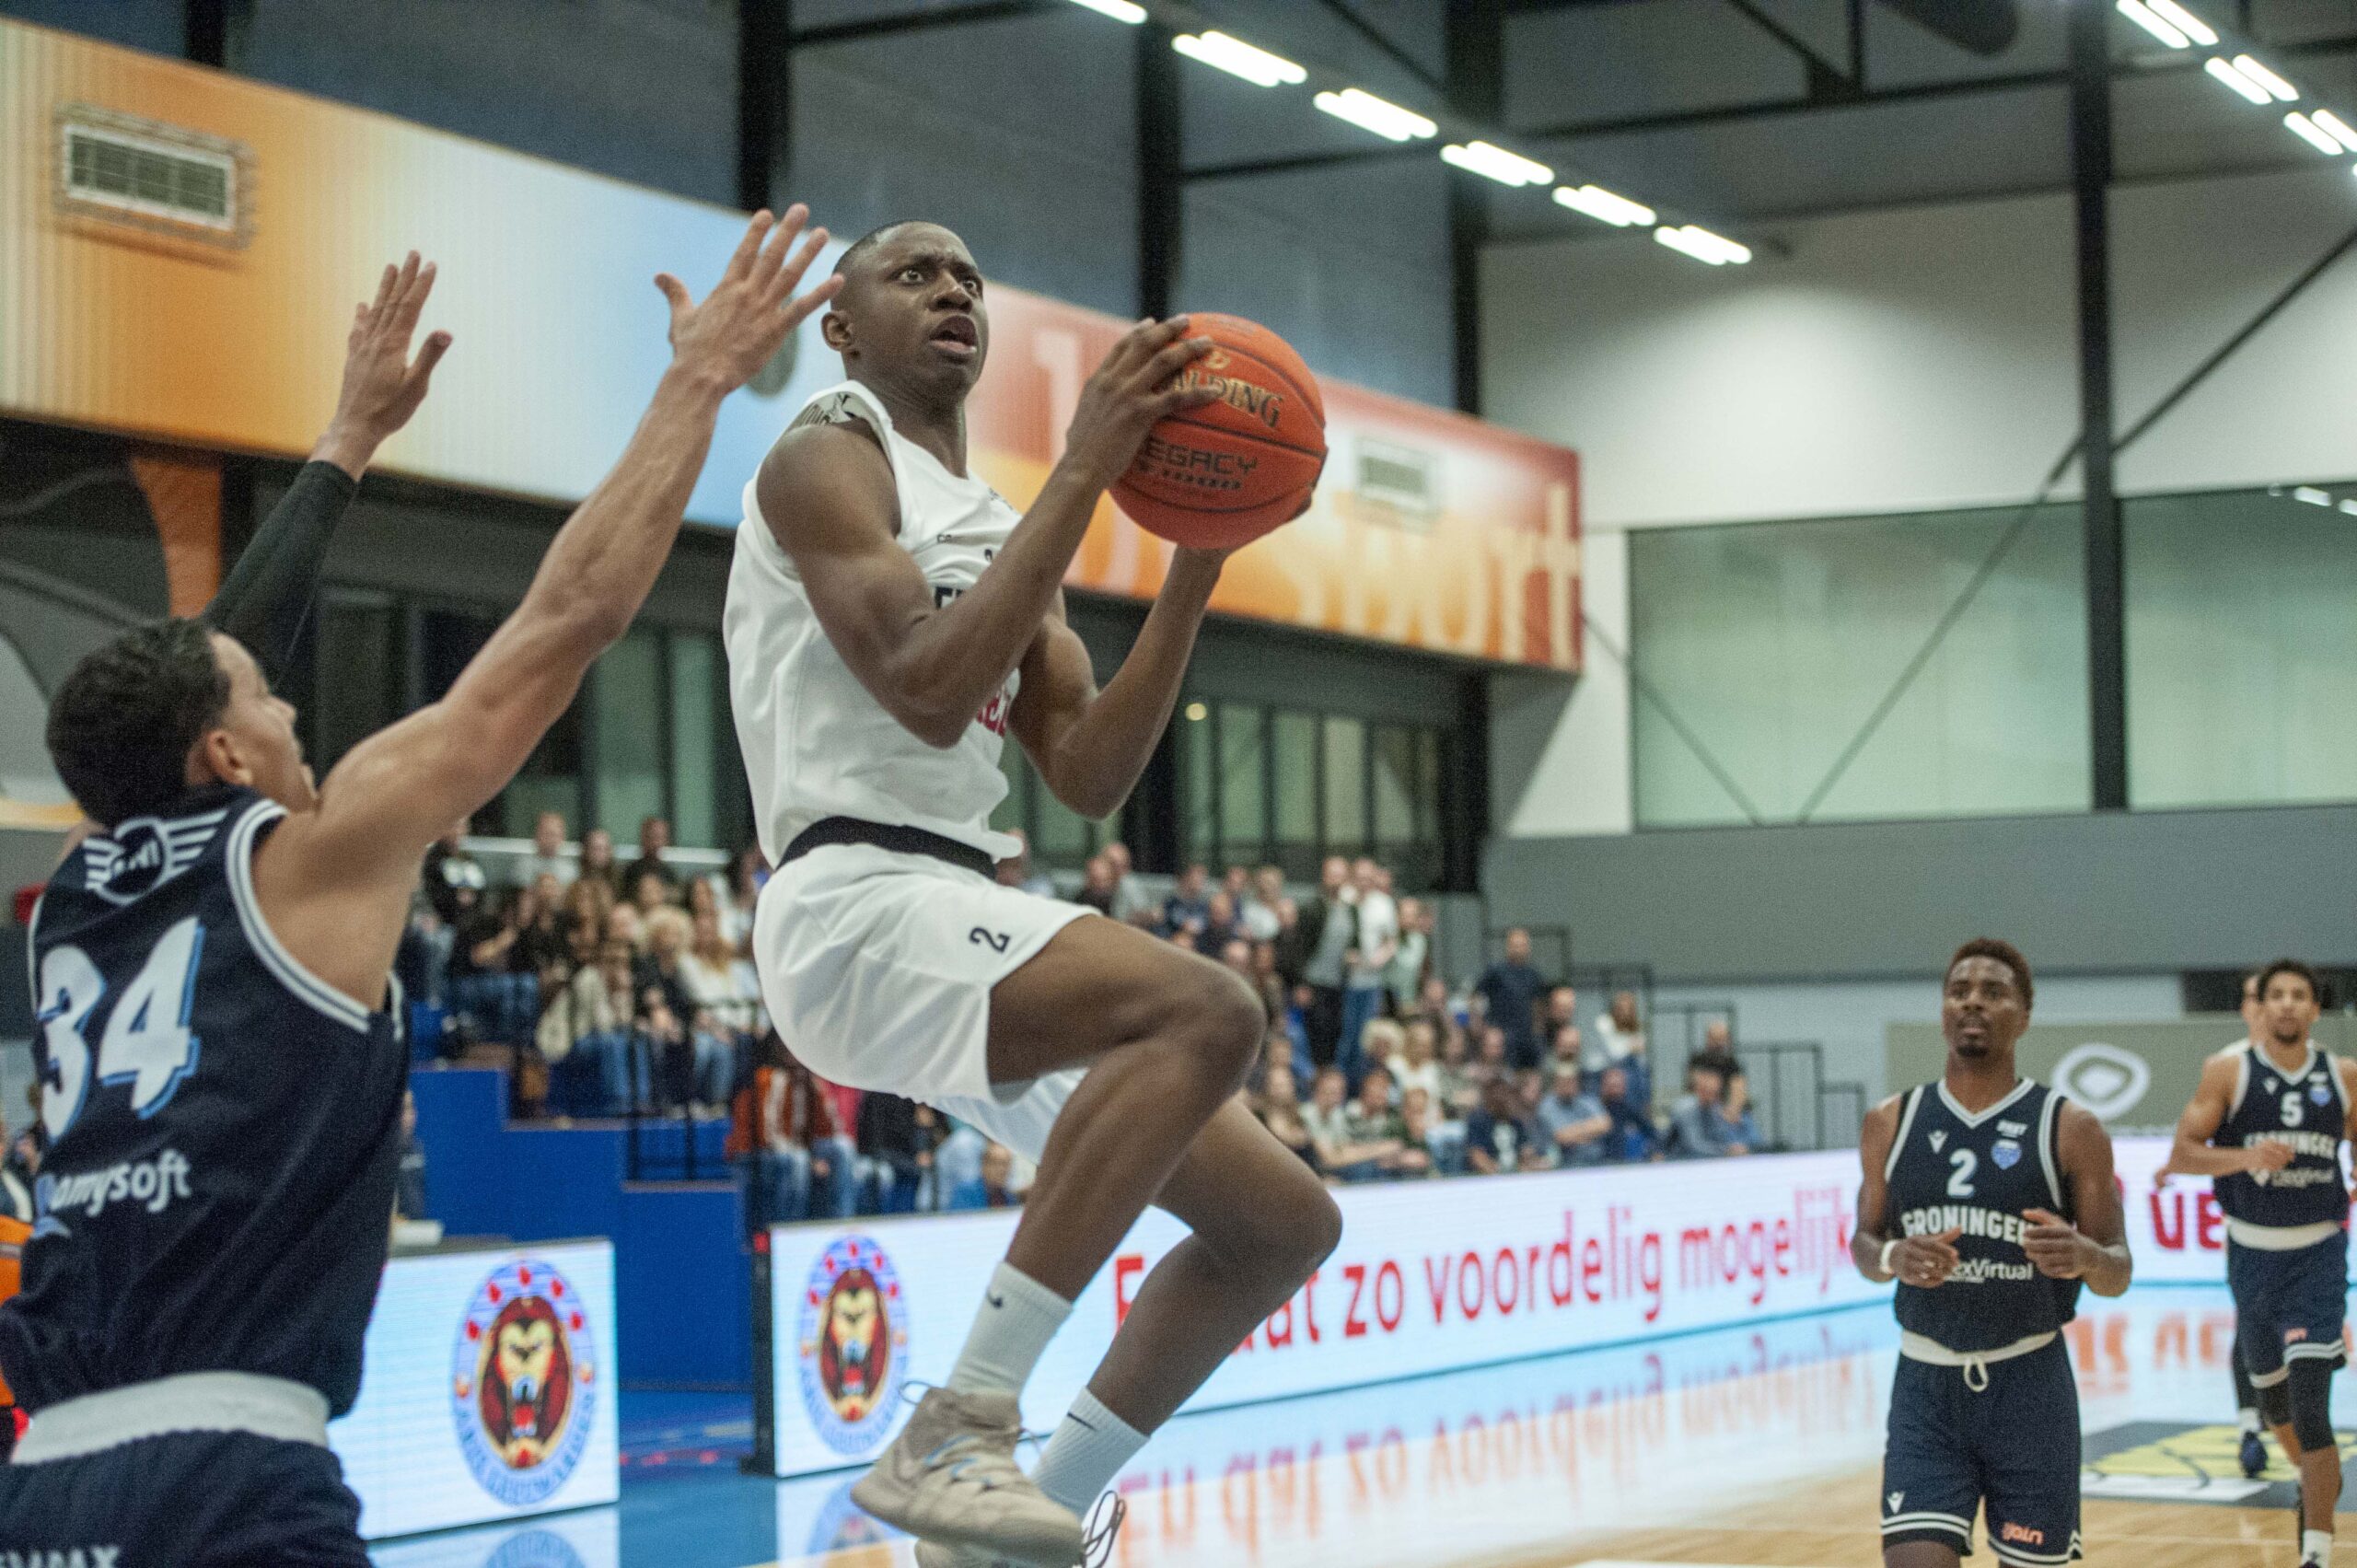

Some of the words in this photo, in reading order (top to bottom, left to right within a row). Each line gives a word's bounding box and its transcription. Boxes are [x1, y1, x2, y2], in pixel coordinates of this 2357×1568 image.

[1173, 368, 1284, 429] ALDING
[1144, 436, 1258, 476] EGACY
[970, 926, 1010, 954] 2
[39, 915, 206, 1144] 34
[2281, 1091, 2305, 1129] 5
[1946, 1147, 1978, 1199] 2
[1232, 1272, 1320, 1354] at
[1343, 1260, 1405, 1337] zo
[1424, 1206, 1662, 1324] voordelig
